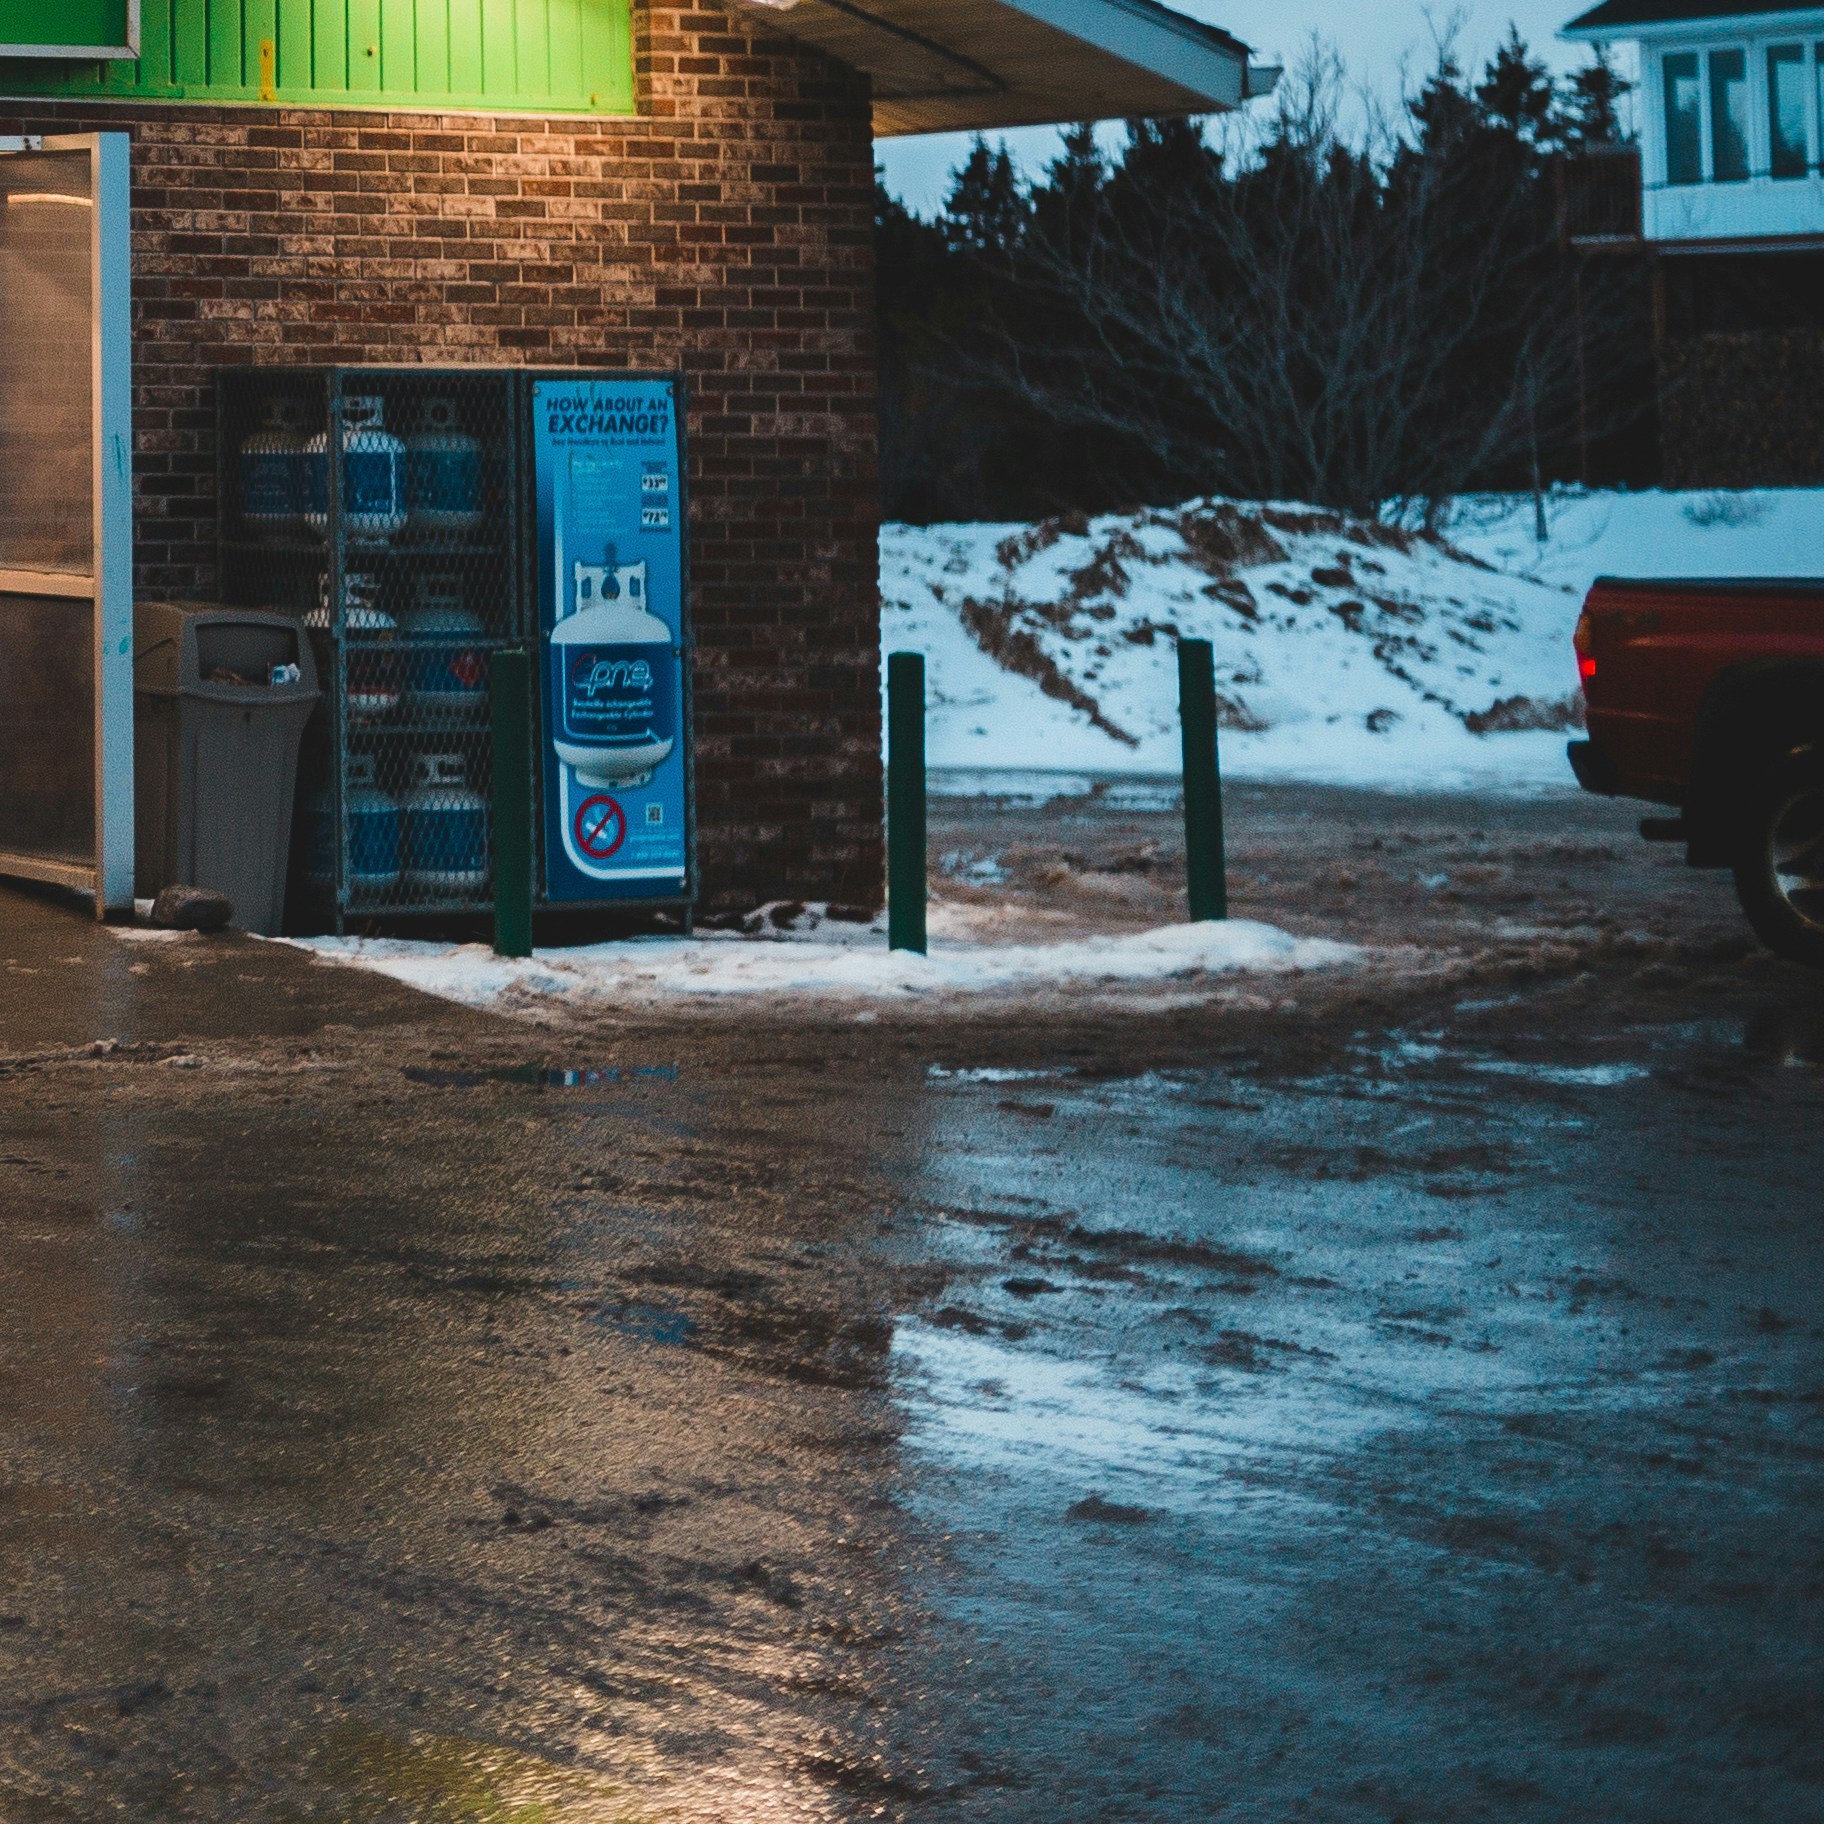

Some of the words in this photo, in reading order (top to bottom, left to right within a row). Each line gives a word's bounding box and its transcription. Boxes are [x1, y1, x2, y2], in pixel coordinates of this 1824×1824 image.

[546, 397, 589, 412] HOW
[592, 397, 644, 412] ABOUT
[646, 397, 668, 412] AN
[547, 414, 670, 434] EXCHANGE?
